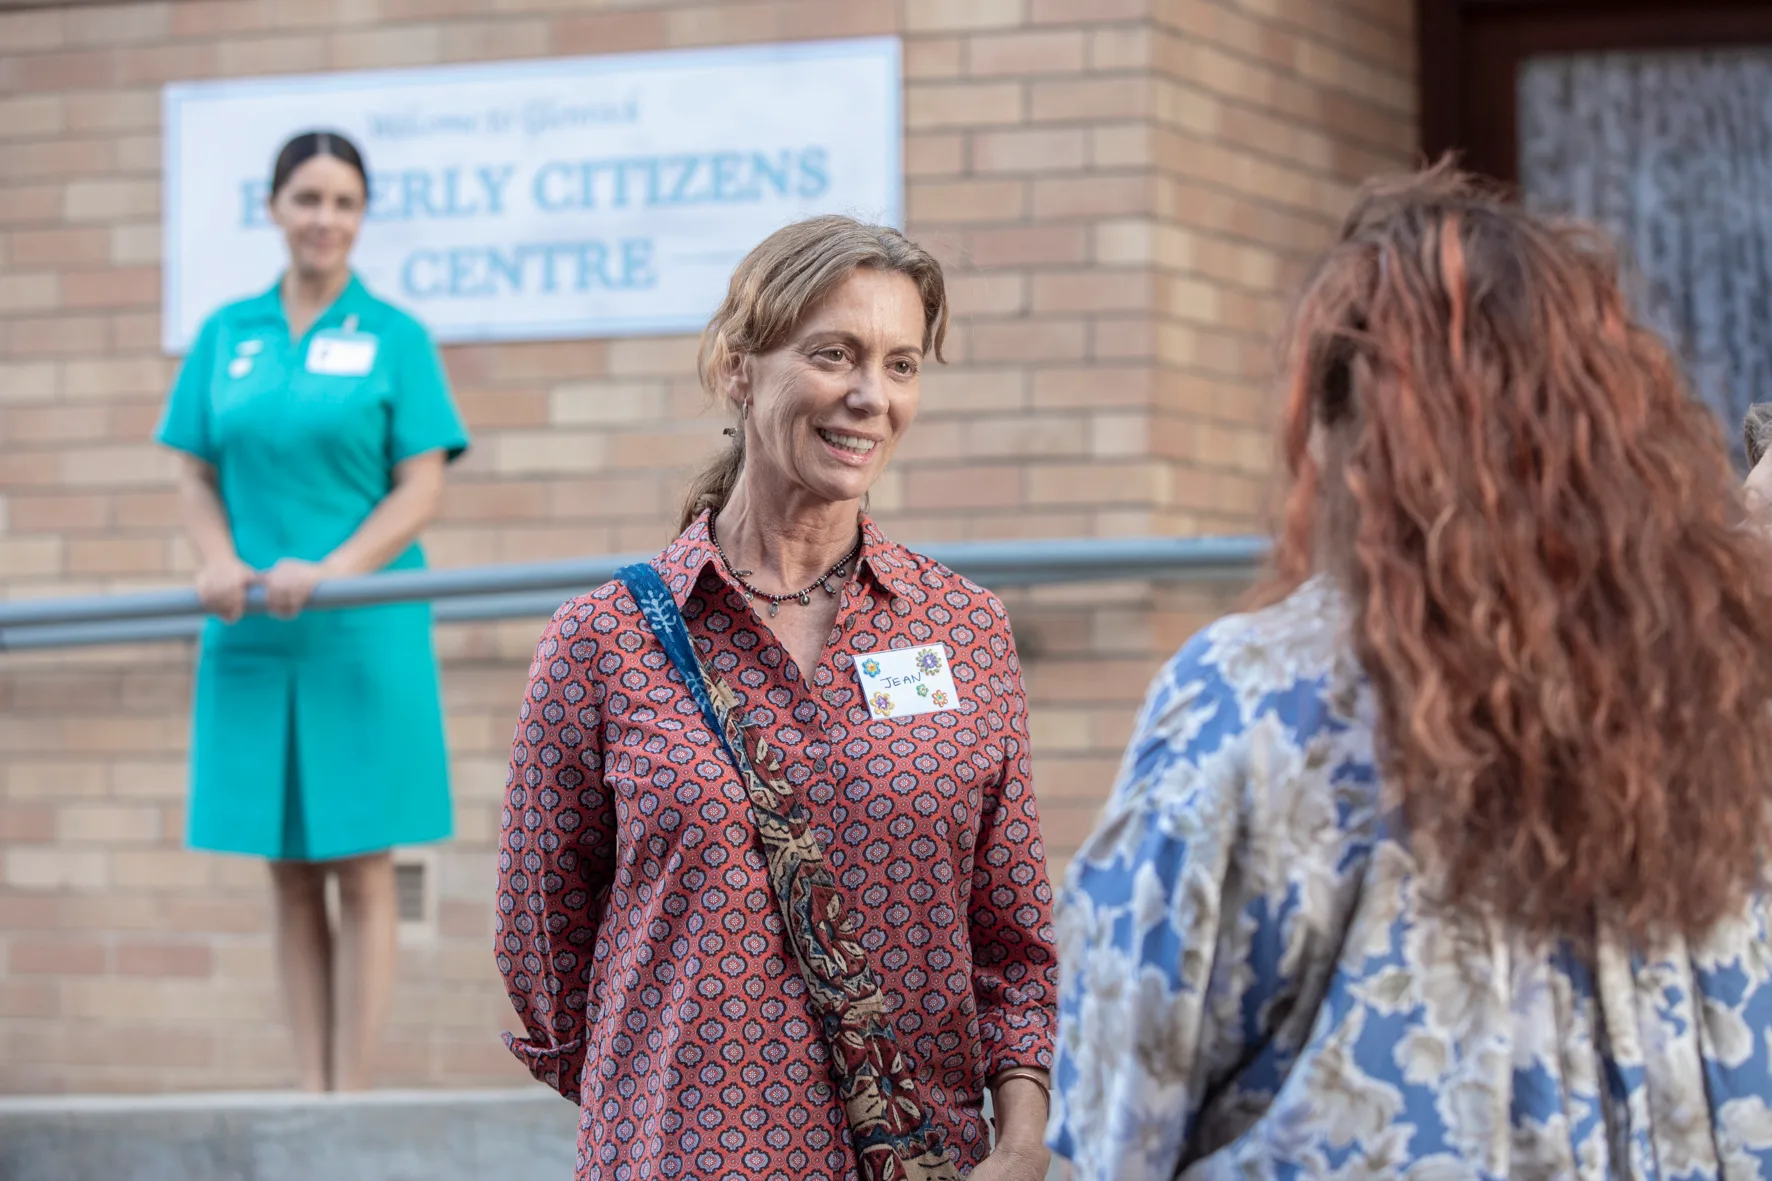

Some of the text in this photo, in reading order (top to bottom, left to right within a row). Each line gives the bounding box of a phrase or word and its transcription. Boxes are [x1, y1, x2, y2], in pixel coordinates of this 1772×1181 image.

[238, 146, 830, 229] EERLY CITIZENS
[402, 237, 656, 298] CENTRE
[880, 672, 922, 689] JEAN
